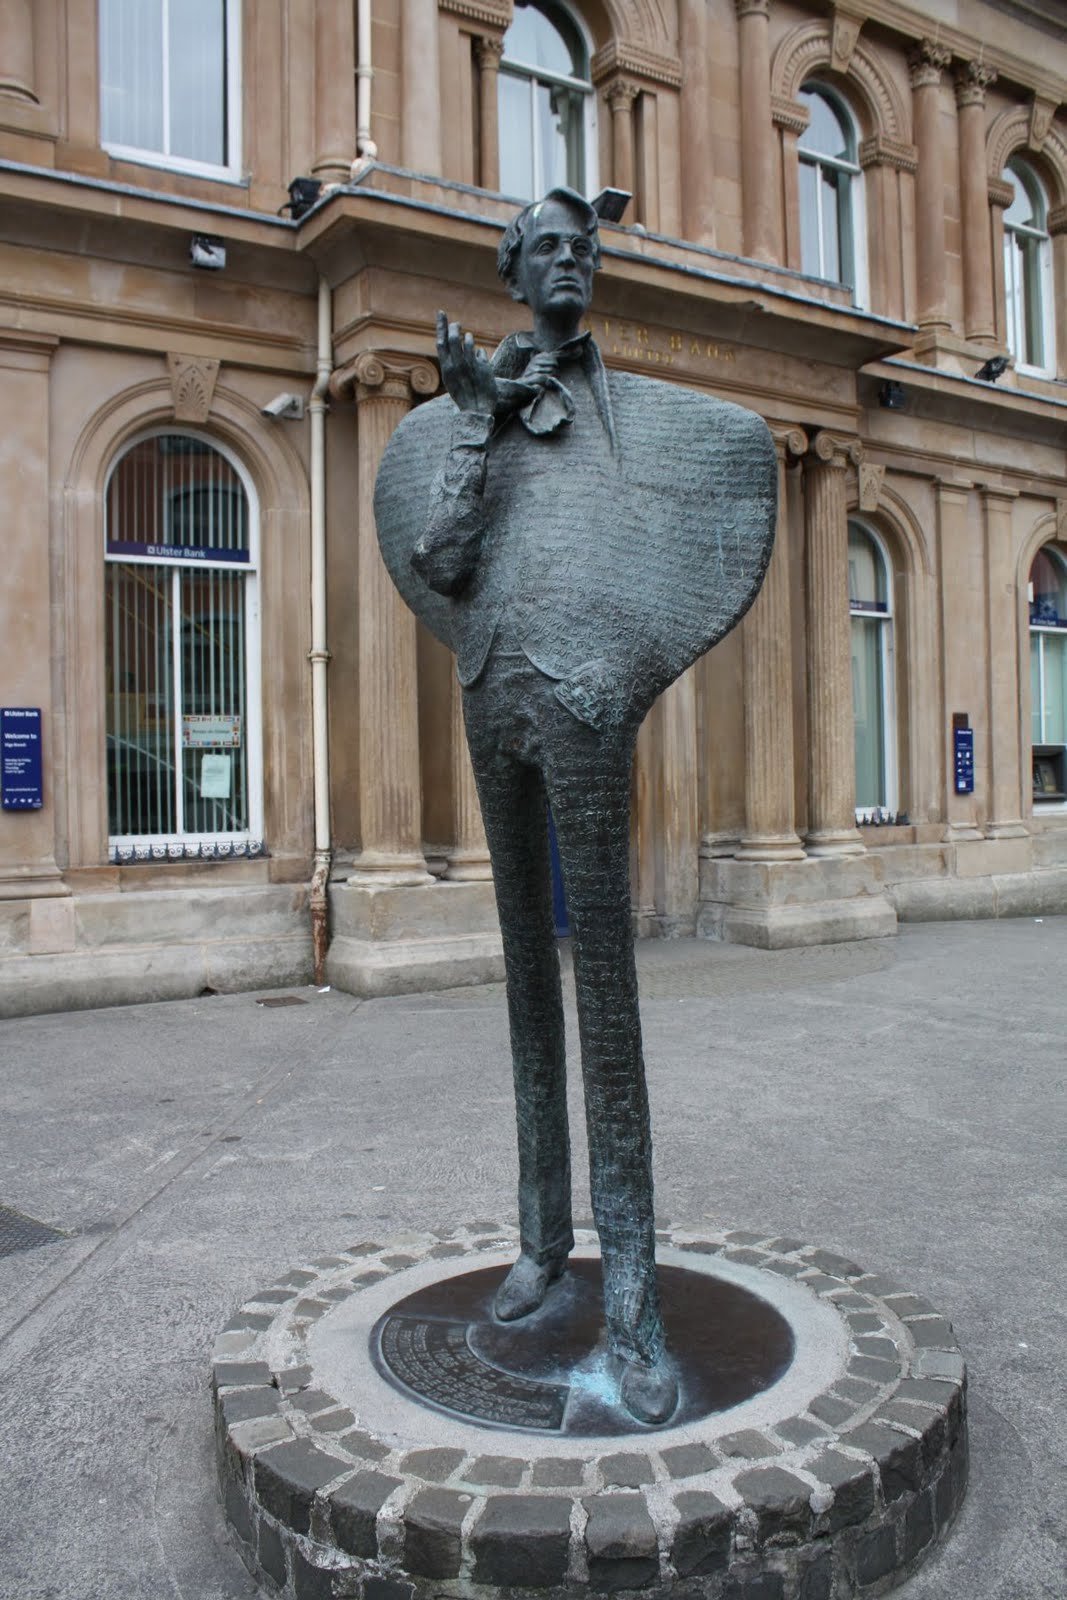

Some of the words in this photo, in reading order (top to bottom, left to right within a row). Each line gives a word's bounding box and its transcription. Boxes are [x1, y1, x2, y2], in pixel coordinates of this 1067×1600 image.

[583, 314, 649, 344] STER
[156, 546, 182, 557] Ulster
[184, 548, 206, 558] Bank
[425, 1390, 475, 1412] ULSTER
[452, 1392, 495, 1408] SLIGO
